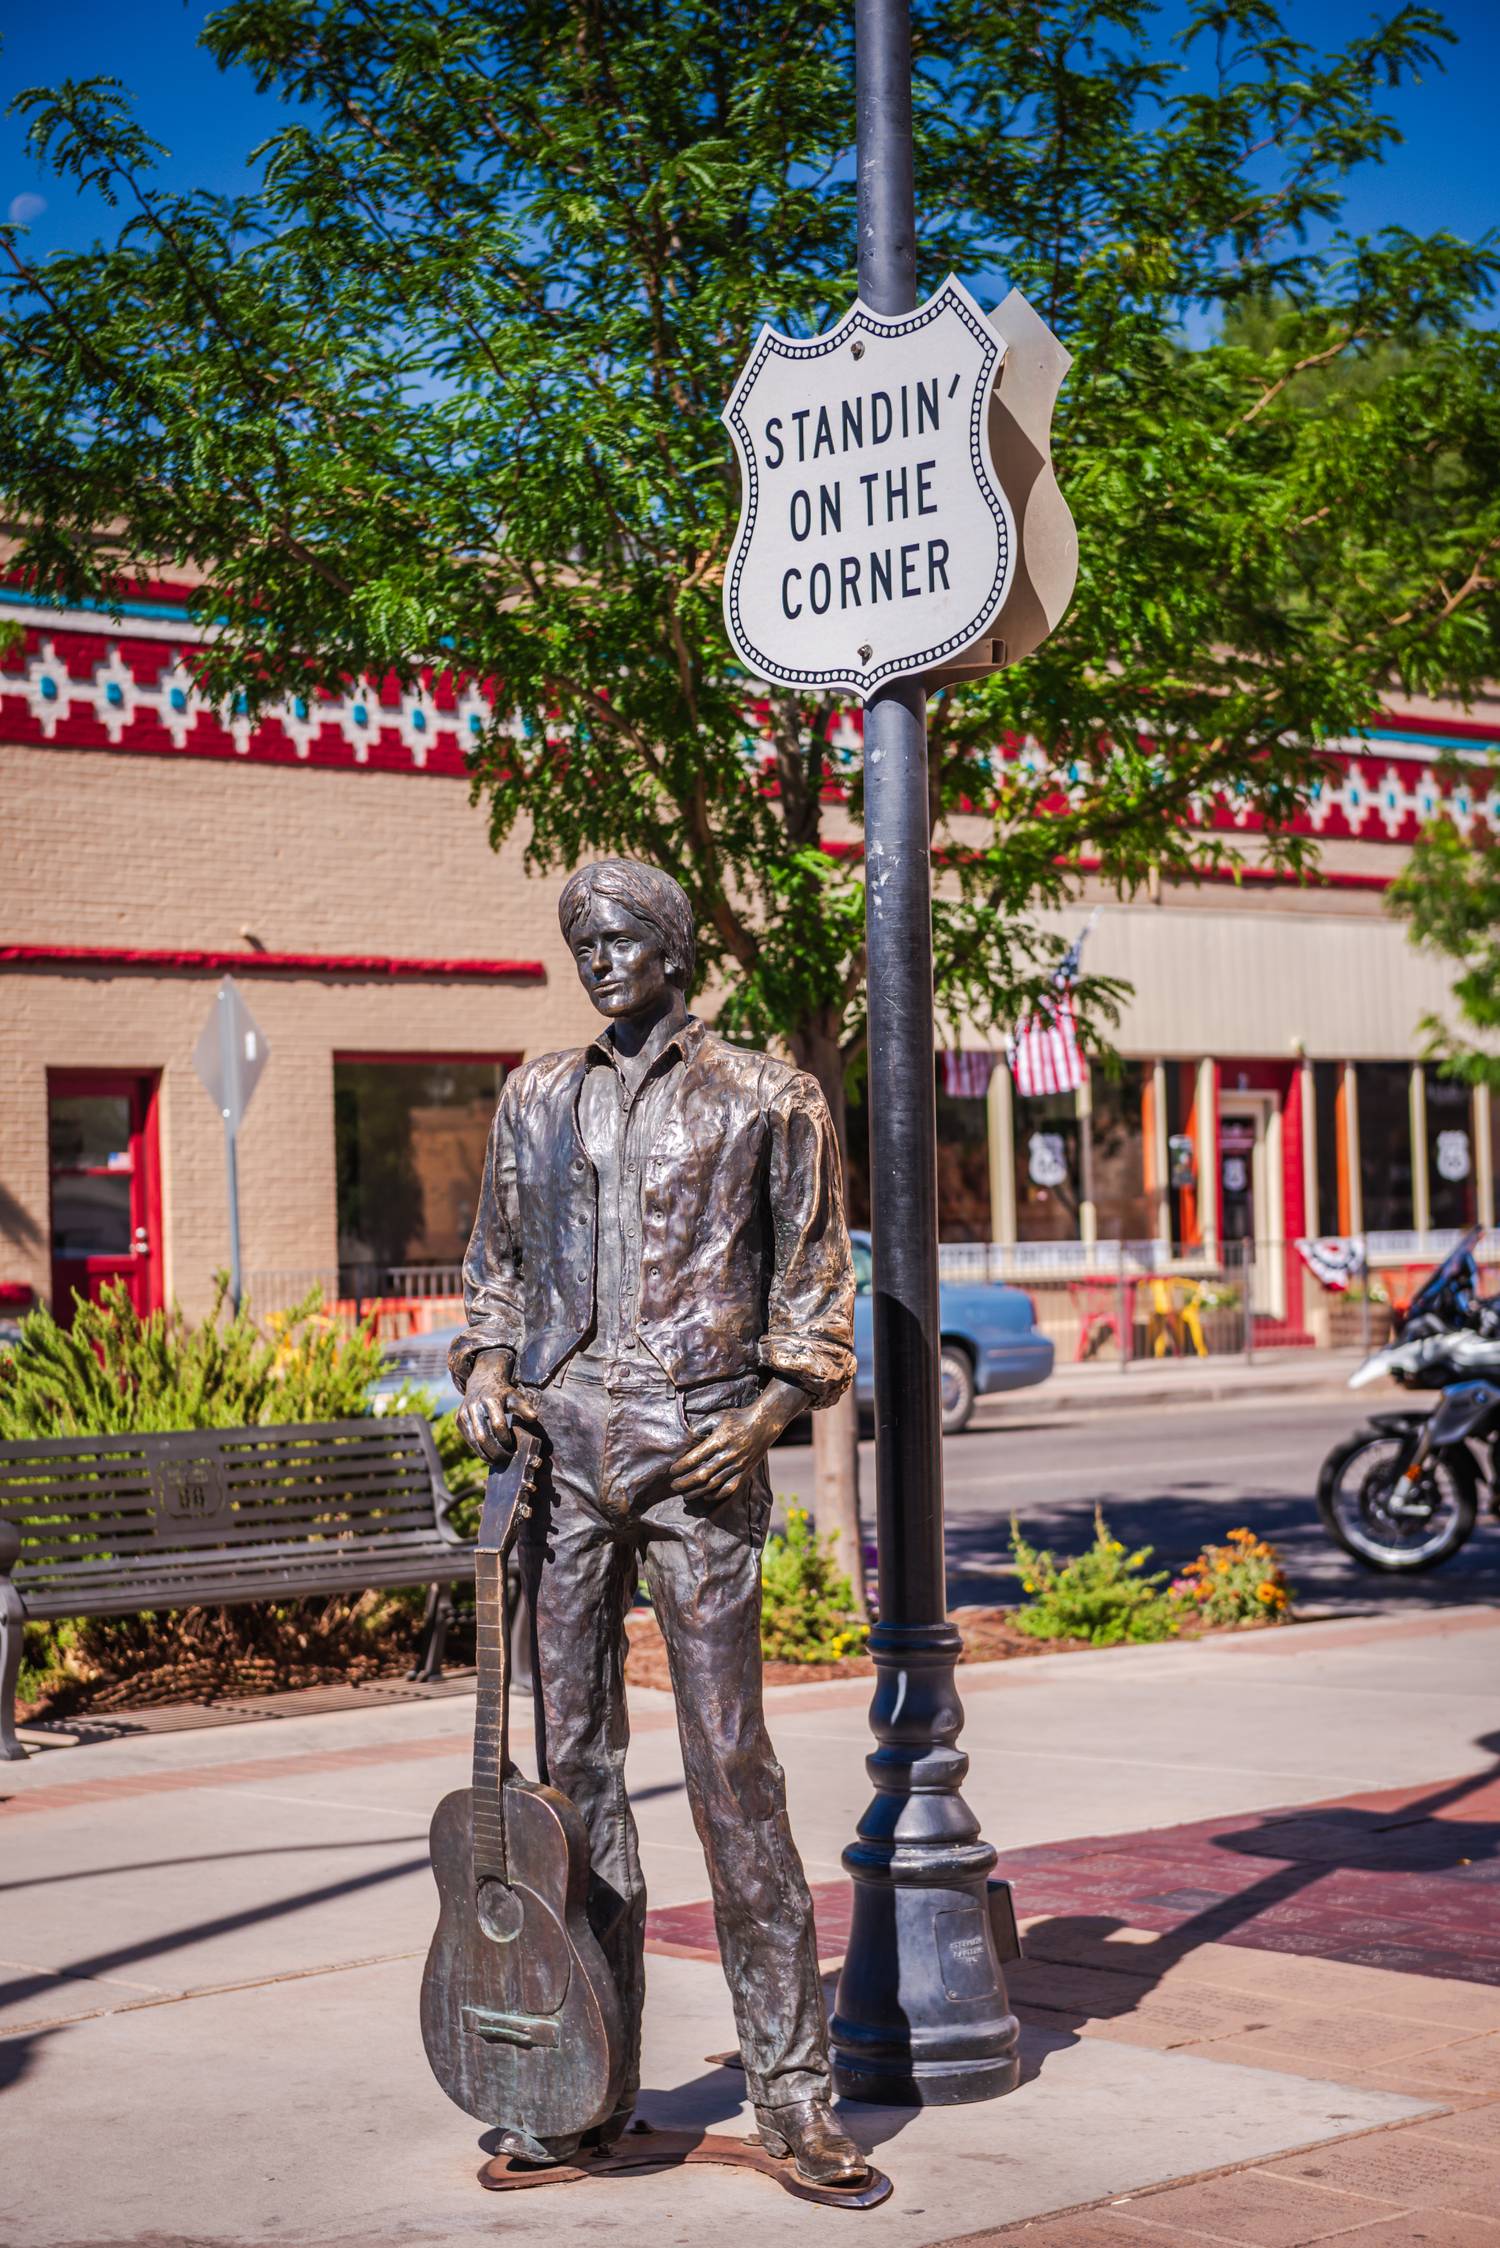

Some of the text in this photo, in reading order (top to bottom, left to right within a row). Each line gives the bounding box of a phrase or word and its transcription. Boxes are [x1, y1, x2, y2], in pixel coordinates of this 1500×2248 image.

[765, 374, 960, 469] STANDIN'
[790, 460, 938, 542] ON THE
[782, 538, 950, 620] CORNER
